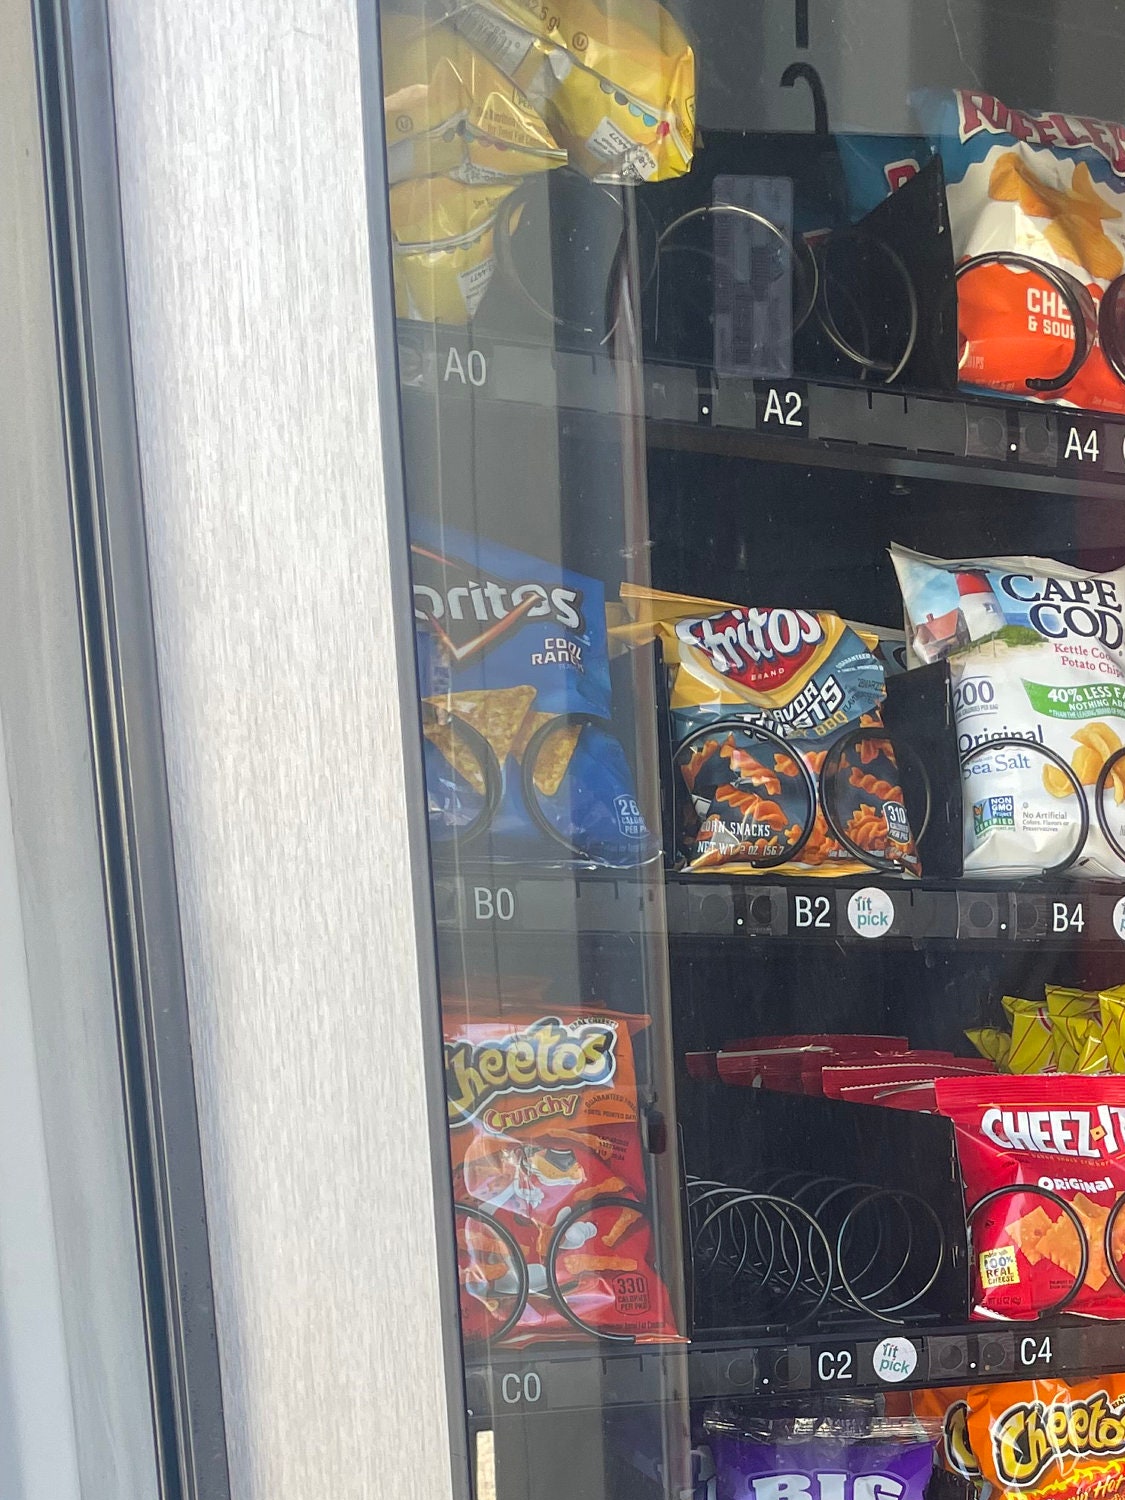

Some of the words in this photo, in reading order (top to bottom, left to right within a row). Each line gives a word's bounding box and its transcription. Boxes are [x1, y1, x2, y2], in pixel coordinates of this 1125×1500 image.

[443, 347, 487, 387] A0
[763, 389, 803, 427] A2
[1064, 427, 1099, 462] A4
[1001, 575, 1122, 613] CAPE
[1029, 603, 1123, 650] COD
[1054, 643, 1088, 656] Kettle
[1061, 656, 1096, 670] Potato
[954, 681, 994, 710] 200
[1047, 688, 1083, 703] 40%
[1084, 687, 1111, 700] LESS
[1069, 699, 1109, 711] NOTHING
[995, 754, 1030, 772] Salt
[888, 806, 906, 824] 310
[992, 804, 1013, 812] GMO
[731, 824, 770, 836] SNACKS
[474, 887, 515, 921] B0
[795, 897, 830, 928] B2
[858, 912, 888, 928] pick
[1053, 903, 1085, 933] B4
[486, 1094, 578, 1131] Crunchy
[617, 1277, 645, 1293] 330
[986, 1268, 1014, 1277] REAL
[1020, 1338, 1052, 1365] C4
[817, 1351, 852, 1381] C2
[880, 1359, 910, 1376] pick
[501, 1373, 541, 1403] C0
